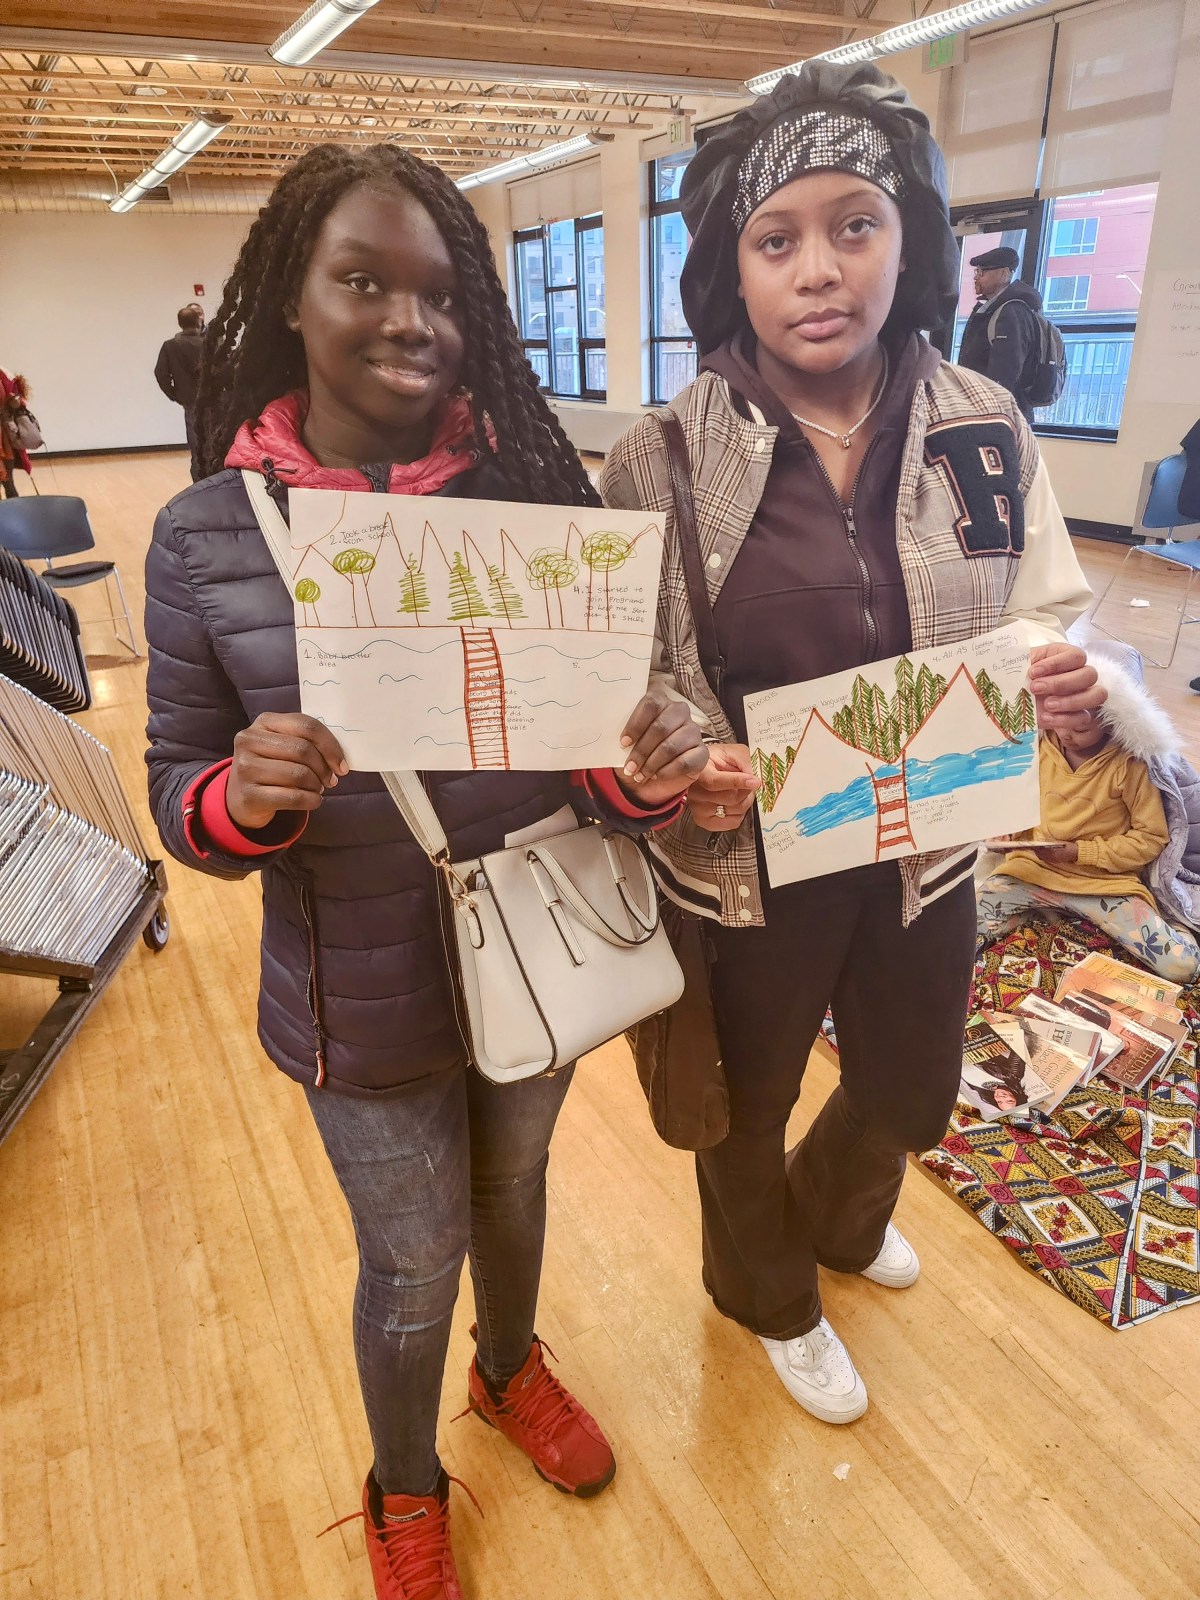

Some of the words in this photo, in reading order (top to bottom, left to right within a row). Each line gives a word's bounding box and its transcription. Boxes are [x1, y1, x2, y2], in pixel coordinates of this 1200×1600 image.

[670, 121, 682, 143] EXIT
[962, 1041, 1009, 1065] BREAKTHR
[1124, 1042, 1160, 1082] ETHUNE
[1039, 1062, 1059, 1081] Geni
[1049, 1060, 1075, 1089] ultivatin
